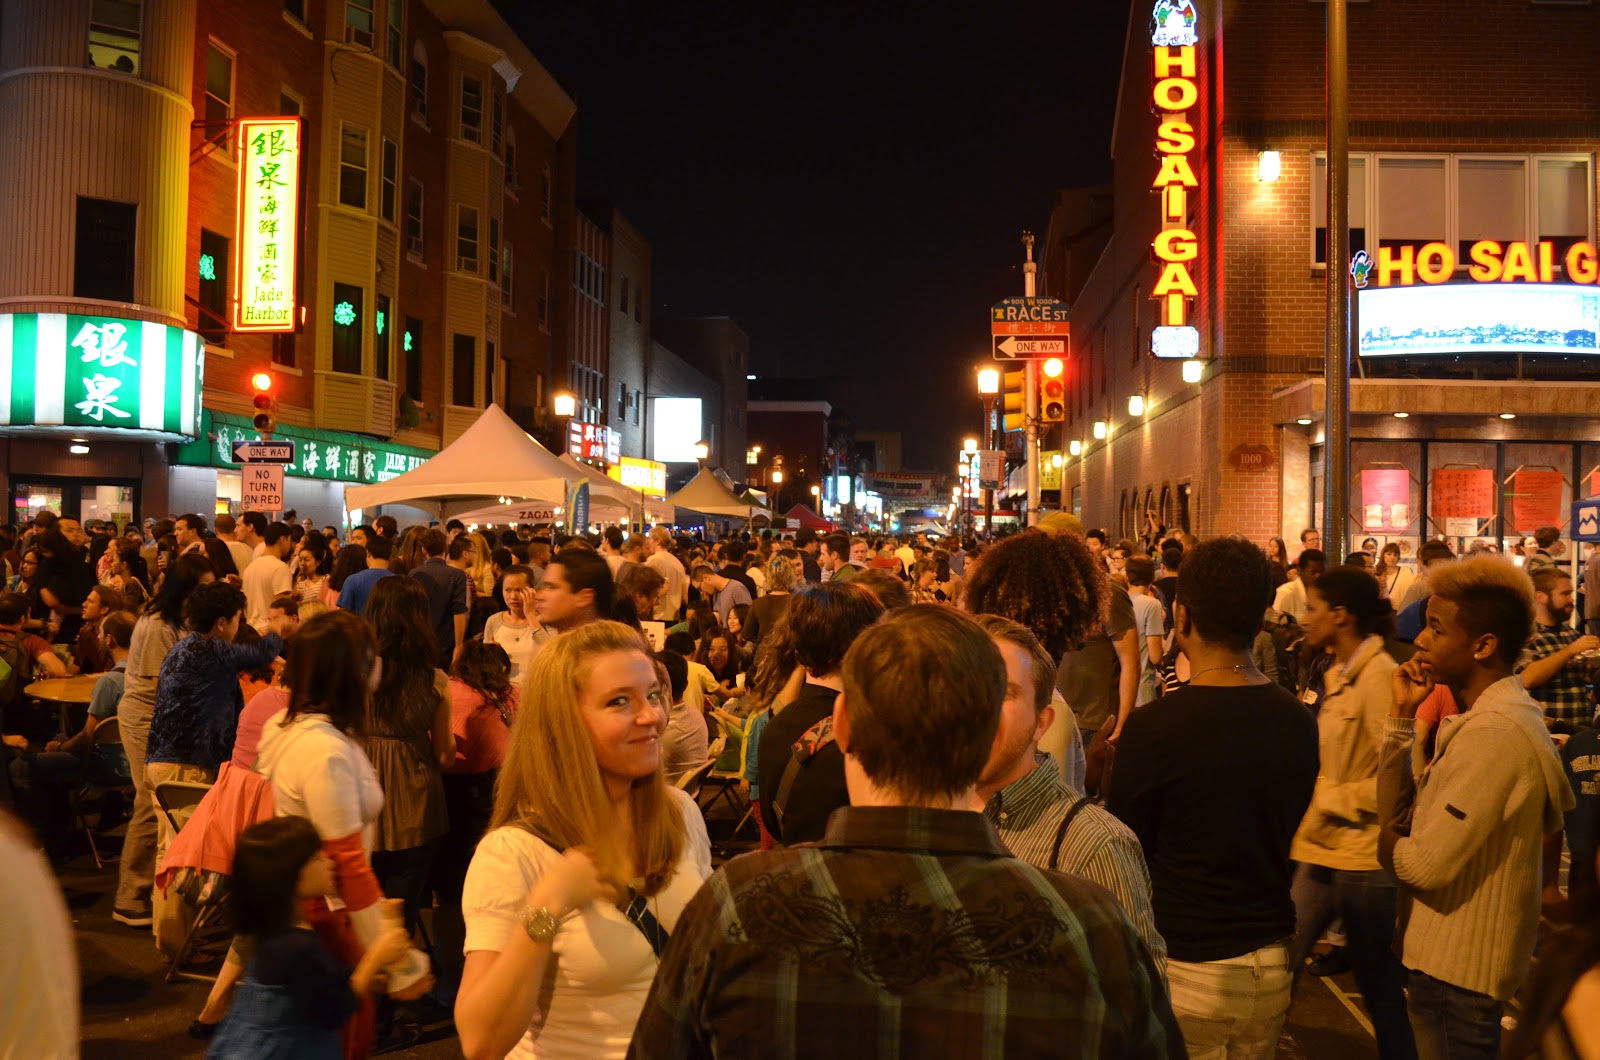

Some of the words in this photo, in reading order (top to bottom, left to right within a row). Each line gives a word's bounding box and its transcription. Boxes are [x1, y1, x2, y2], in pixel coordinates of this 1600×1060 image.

[1154, 45, 1198, 111] HO
[1153, 121, 1199, 218] SAI
[1377, 242, 1455, 287] HO
[1468, 240, 1553, 283] SAI
[1565, 241, 1600, 285] G
[1154, 228, 1199, 326] GAI
[253, 286, 283, 304] Jade
[1027, 298, 1035, 306] W
[245, 306, 289, 321] Harbor
[1006, 306, 1052, 321] RACE
[1053, 310, 1068, 321] ST
[1016, 342, 1037, 352] ONE
[1040, 342, 1061, 352] WAY
[71, 322, 138, 421] 銀泉
[250, 447, 268, 457] ONE
[270, 447, 288, 457] WAY
[282, 438, 377, 480] 海鮮酒家
[1240, 453, 1263, 464] 1000
[384, 452, 407, 472] JADE
[255, 470, 270, 479] NO
[249, 482, 277, 492] TURN
[243, 494, 258, 504] ON
[260, 495, 281, 505] RED
[519, 511, 554, 519] ZAGAT
